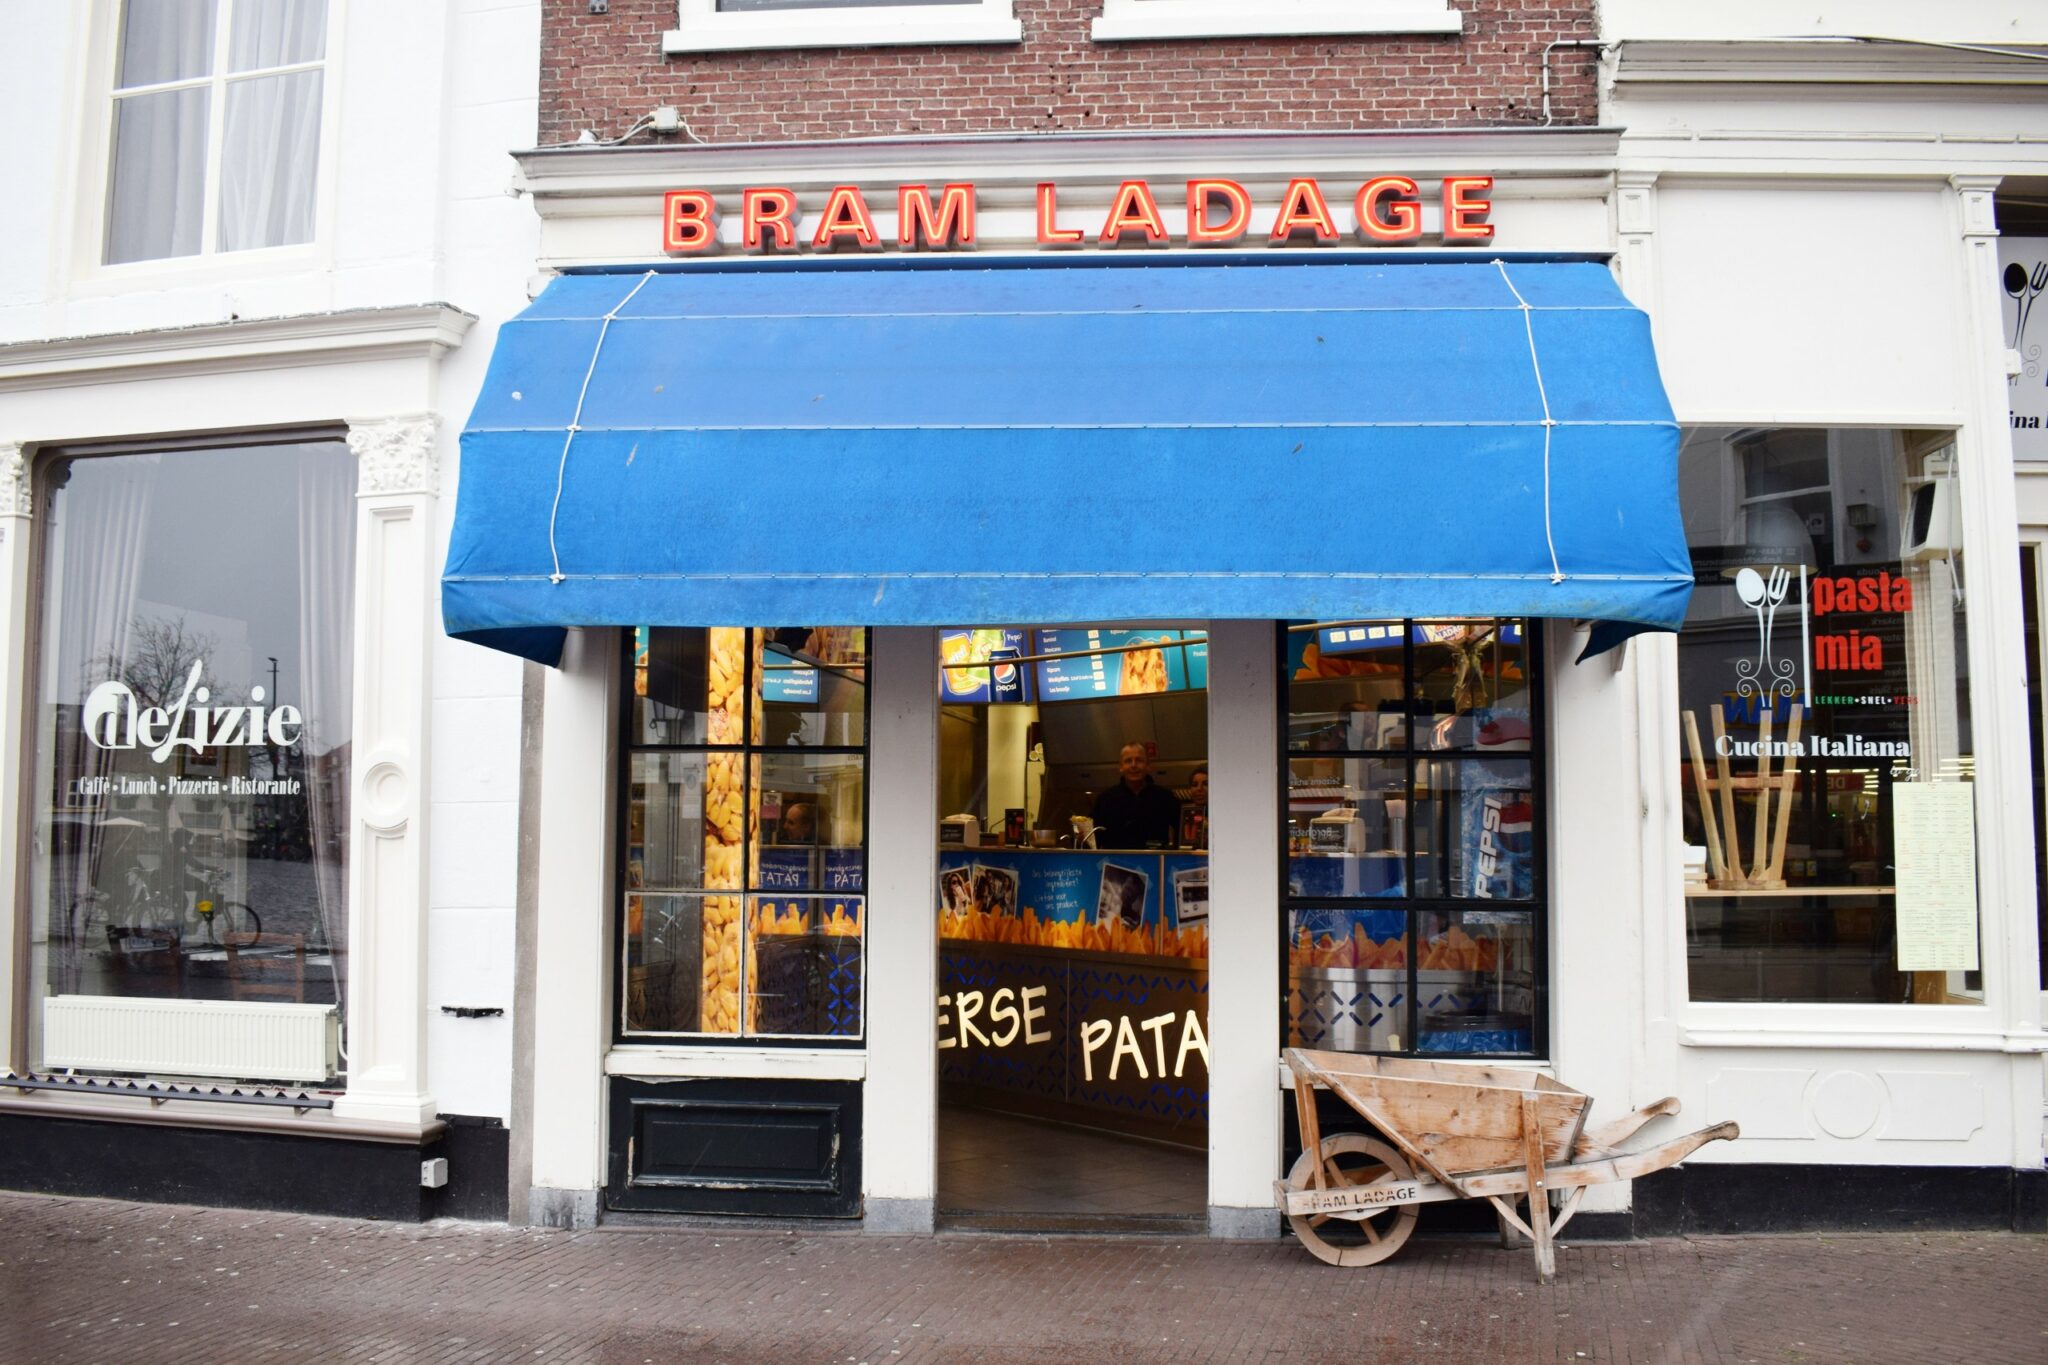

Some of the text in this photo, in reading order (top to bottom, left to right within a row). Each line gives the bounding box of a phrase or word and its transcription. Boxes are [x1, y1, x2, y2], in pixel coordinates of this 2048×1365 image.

[663, 176, 1496, 256] BRAM LADAGE
[2009, 410, 2040, 429] ina
[1813, 572, 1913, 616] pasta
[1815, 630, 1883, 670] mia
[995, 683, 1017, 692] pepsi
[1815, 695, 1854, 705] LEKKER
[1861, 695, 1888, 705] SNEL
[1715, 734, 1911, 758] Cucina Italiana
[79, 776, 300, 796] Caffè Lunch Pizzeria Ristorante
[1475, 797, 1502, 899] PEPSI
[937, 984, 1051, 1050] ERSE
[1080, 1009, 1210, 1082] PATA
[1354, 1186, 1417, 1205] LADAGE
